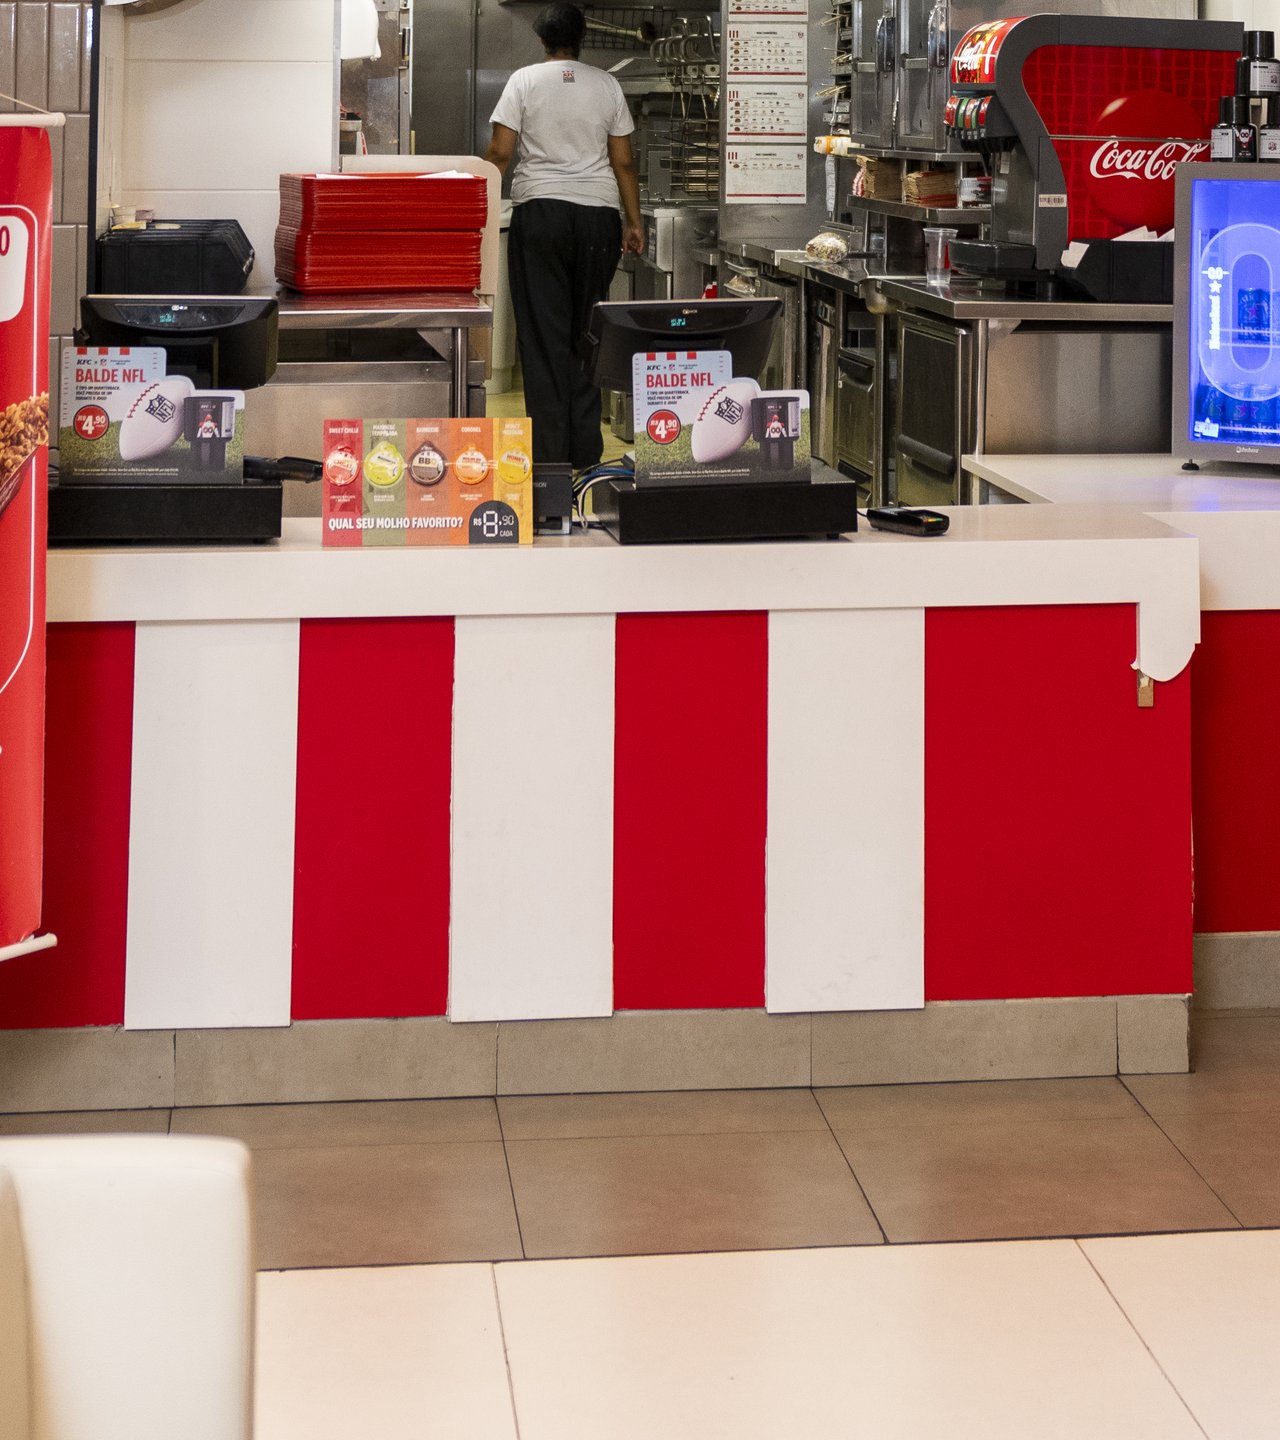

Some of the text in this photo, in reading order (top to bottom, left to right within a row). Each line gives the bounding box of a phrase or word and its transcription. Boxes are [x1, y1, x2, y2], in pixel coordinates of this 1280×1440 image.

[1090, 136, 1209, 180] Coca-Co
[76, 369, 146, 383] BALDE NFL
[329, 517, 463, 529] QUAL SEU MOLHO FAVORITO?
